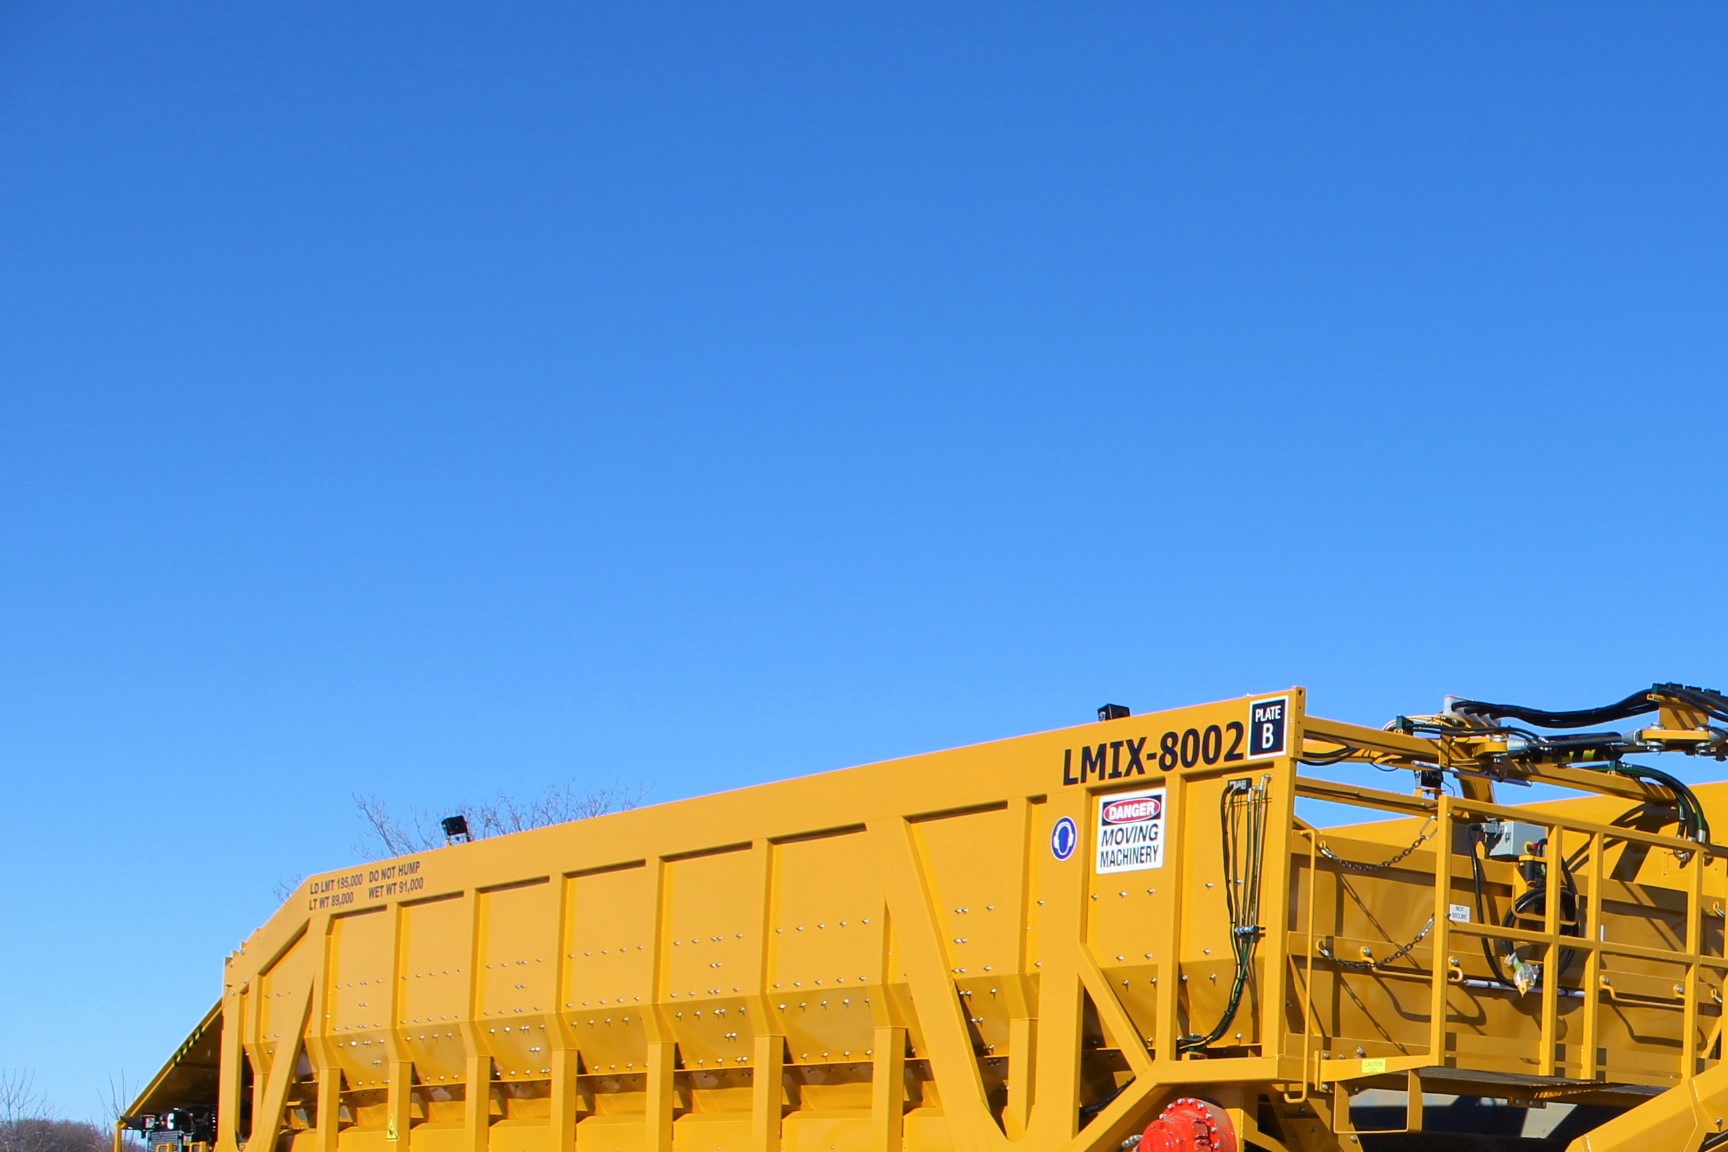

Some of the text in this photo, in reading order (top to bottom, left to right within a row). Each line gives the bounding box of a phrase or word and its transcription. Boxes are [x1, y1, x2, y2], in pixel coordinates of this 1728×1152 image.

[1255, 705, 1281, 722] PLATE
[1262, 723, 1274, 749] B
[1063, 721, 1244, 786] LMIX-8002
[1109, 801, 1155, 819] DANGER
[1102, 823, 1159, 847] MOVING
[1100, 844, 1159, 868] MACHINERY
[369, 861, 421, 883] DO NOT HUMP
[310, 873, 363, 895] LD LMT 195,000
[368, 877, 424, 899] WET WT 91,000
[309, 891, 354, 911] LT WT 89,000
